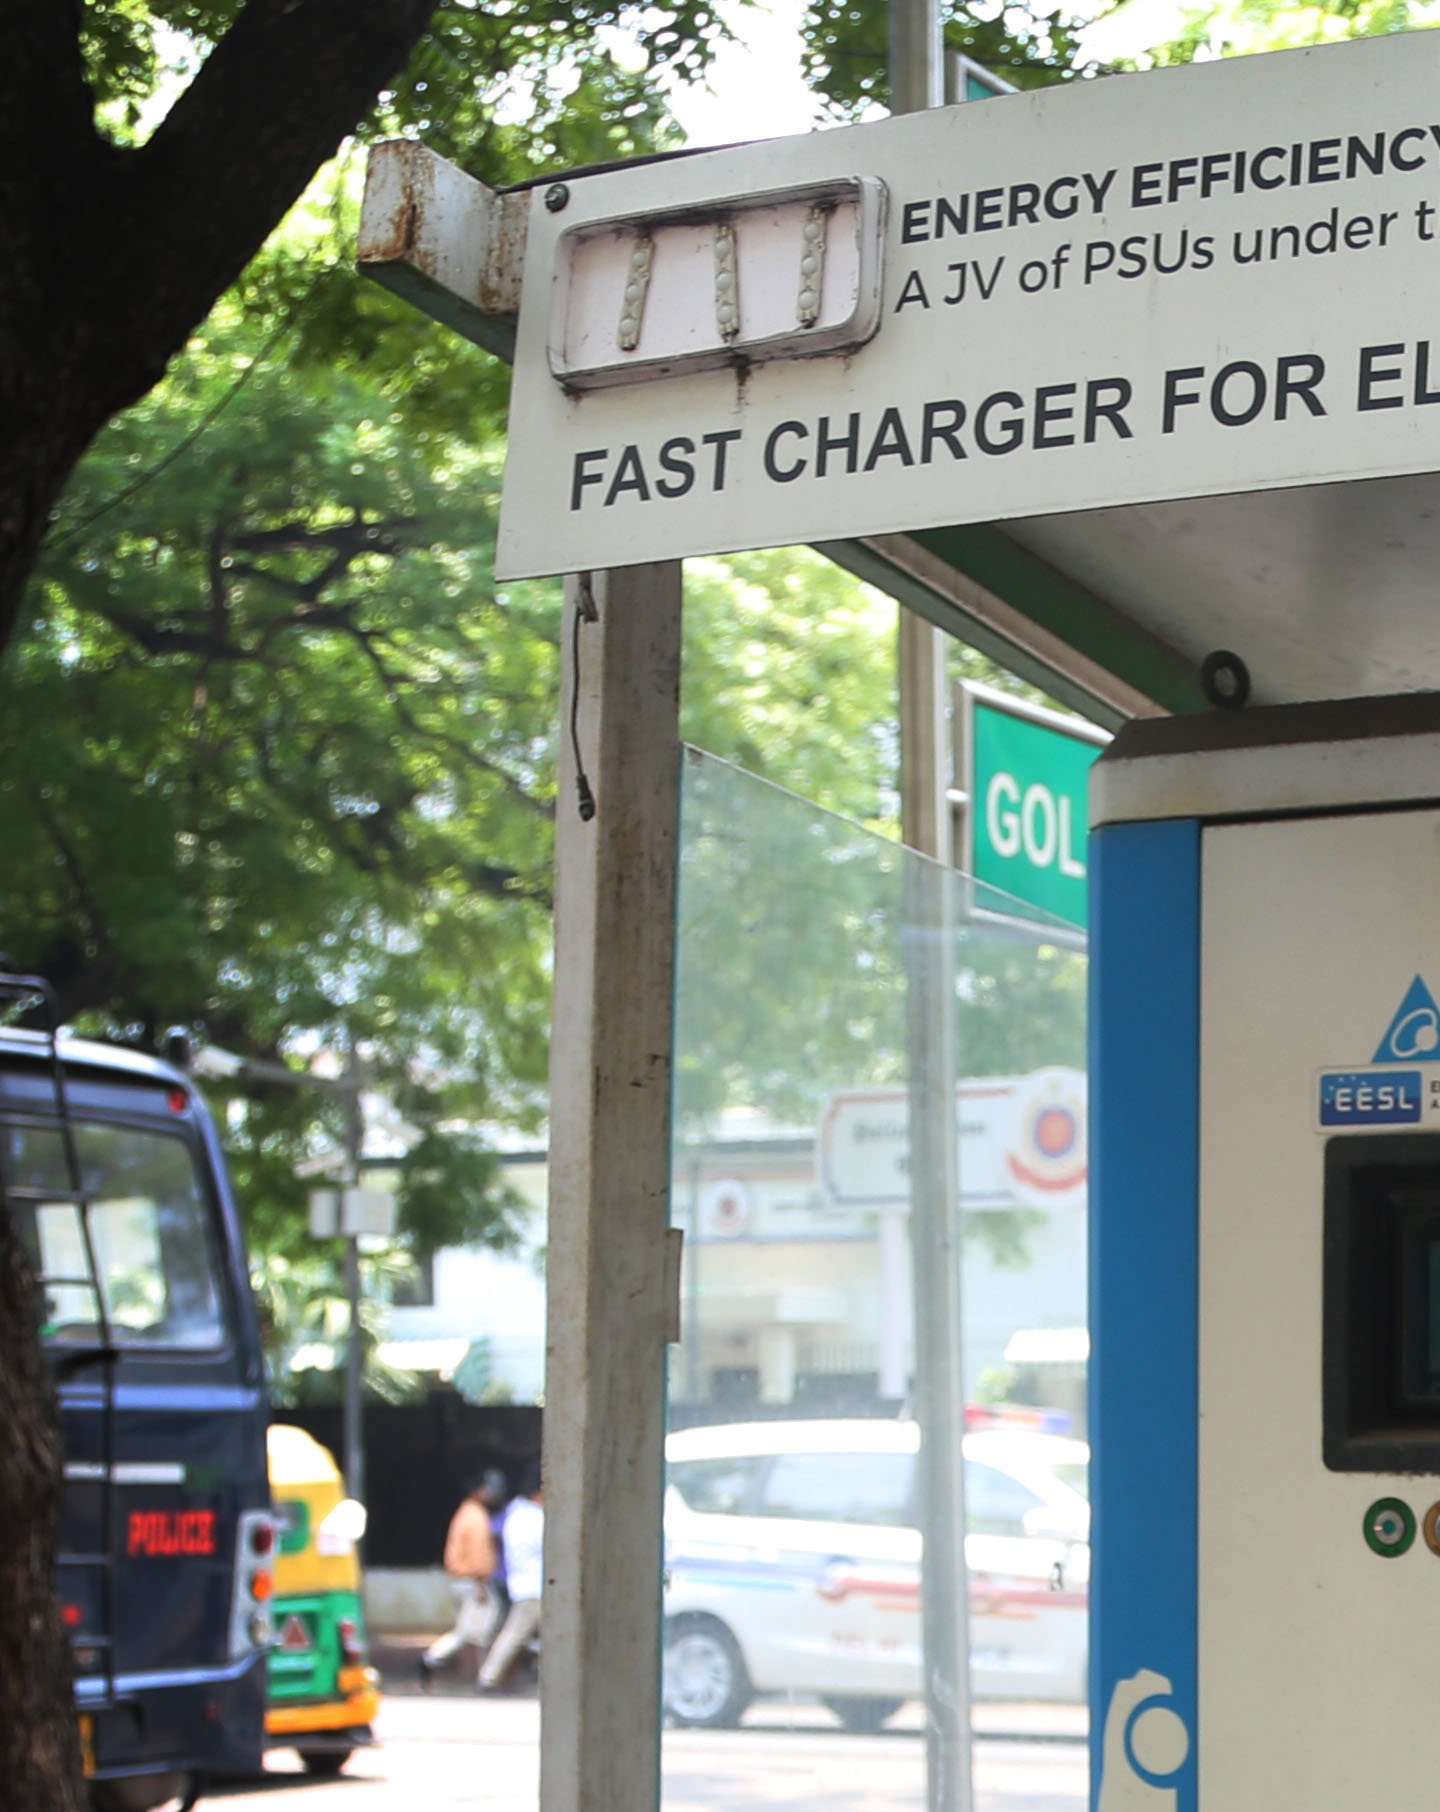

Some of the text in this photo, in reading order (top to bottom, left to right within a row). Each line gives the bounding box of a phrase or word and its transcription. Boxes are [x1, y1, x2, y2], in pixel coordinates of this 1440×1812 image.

[901, 170, 1115, 244] ENERGY
[894, 268, 931, 313] A
[944, 258, 1005, 306] JV
[1018, 244, 1073, 293] of
[1084, 227, 1215, 284] PSUs
[1230, 206, 1400, 265] under
[570, 429, 742, 512] FAST
[763, 376, 1133, 484] CHARGER
[1161, 353, 1327, 434] FOR
[987, 772, 1086, 878] GOL
[1335, 1086, 1414, 1112] EESL
[128, 1510, 216, 1556] POLICE
